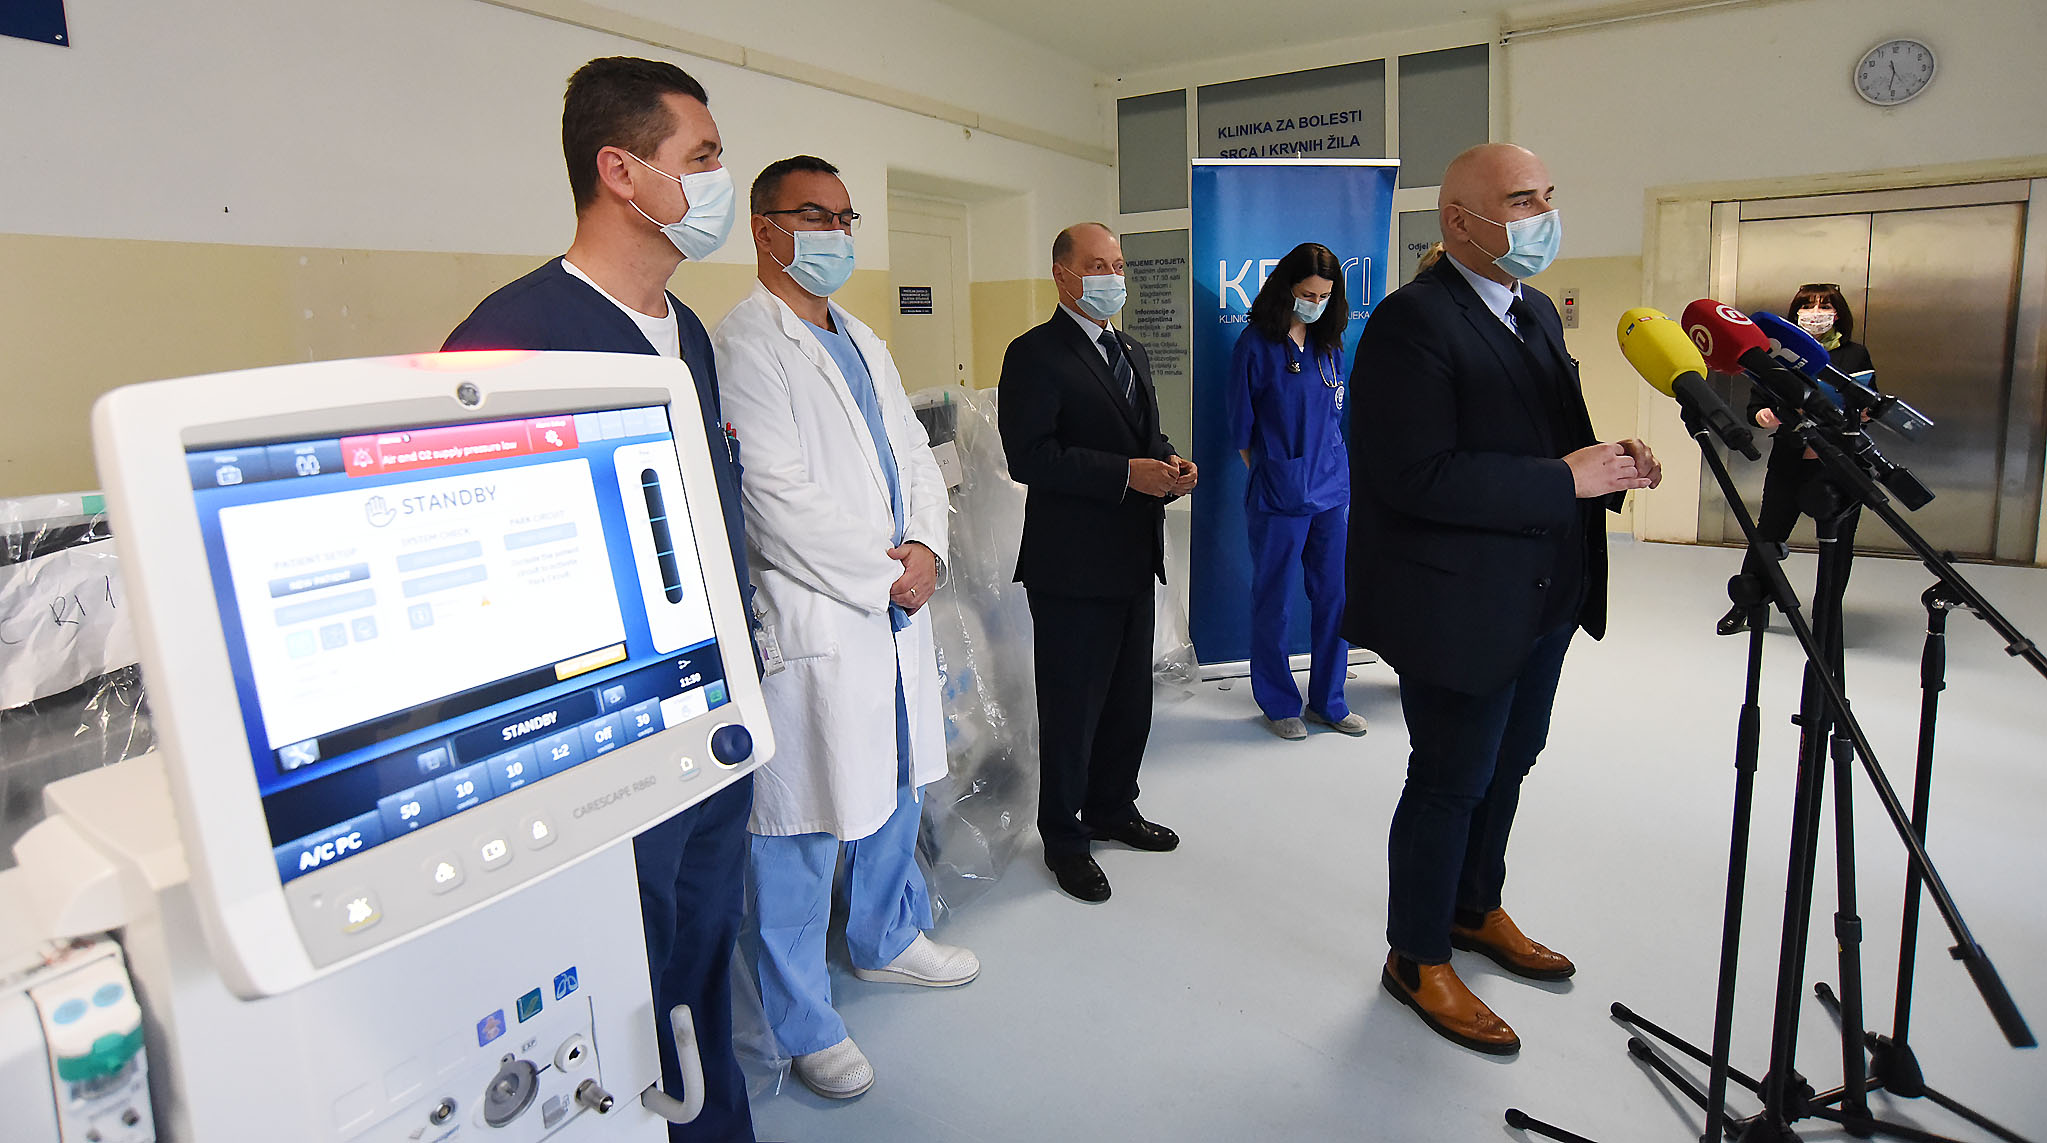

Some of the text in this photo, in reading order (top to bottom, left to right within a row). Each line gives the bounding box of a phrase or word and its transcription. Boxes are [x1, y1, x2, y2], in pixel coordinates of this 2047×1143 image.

[1218, 109, 1362, 139] KLINIKA ZA BOLESTI
[1220, 134, 1360, 158] SRCA I KRVNIH ŽILA
[1155, 257, 1185, 265] POSJETA
[434, 446, 463, 460] supply
[402, 484, 497, 515] STANDBY
[502, 710, 558, 741] STANDBY
[635, 712, 651, 728] 30
[594, 726, 613, 743] Off
[552, 743, 570, 760] 1:2
[505, 761, 523, 779] 10
[455, 780, 475, 799] 10
[400, 801, 421, 820] 50
[572, 785, 632, 819] CARESCAPE
[298, 842, 336, 871] A/C
[335, 831, 363, 856] PC
